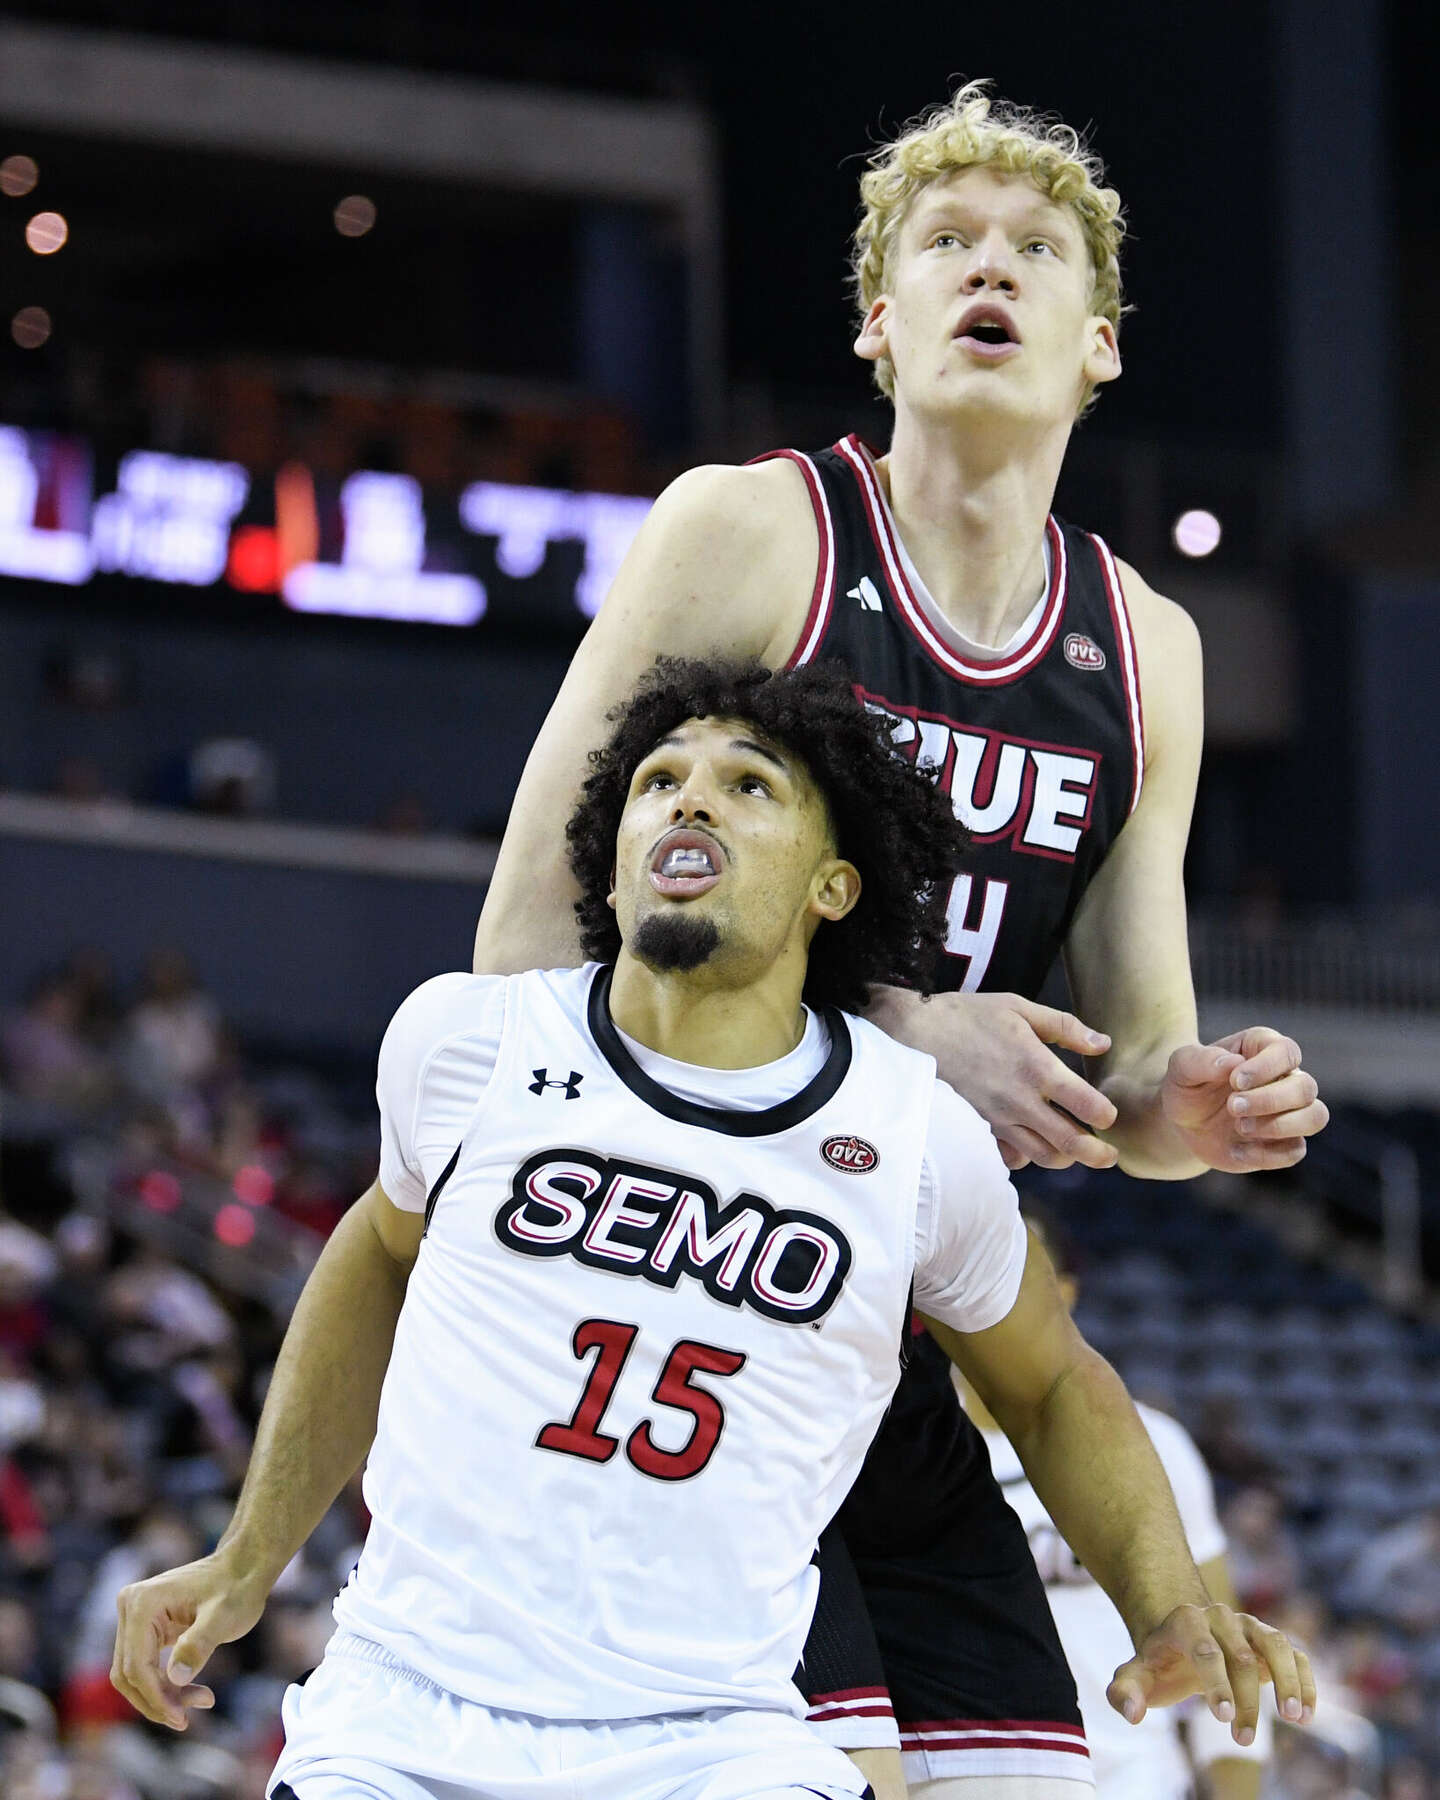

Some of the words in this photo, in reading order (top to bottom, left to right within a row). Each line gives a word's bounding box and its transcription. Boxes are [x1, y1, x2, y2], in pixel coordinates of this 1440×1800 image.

[1069, 642, 1099, 661] OVC
[831, 1144, 868, 1166] OVC
[507, 1160, 841, 1311] SEMO
[533, 1318, 748, 1482] 15
